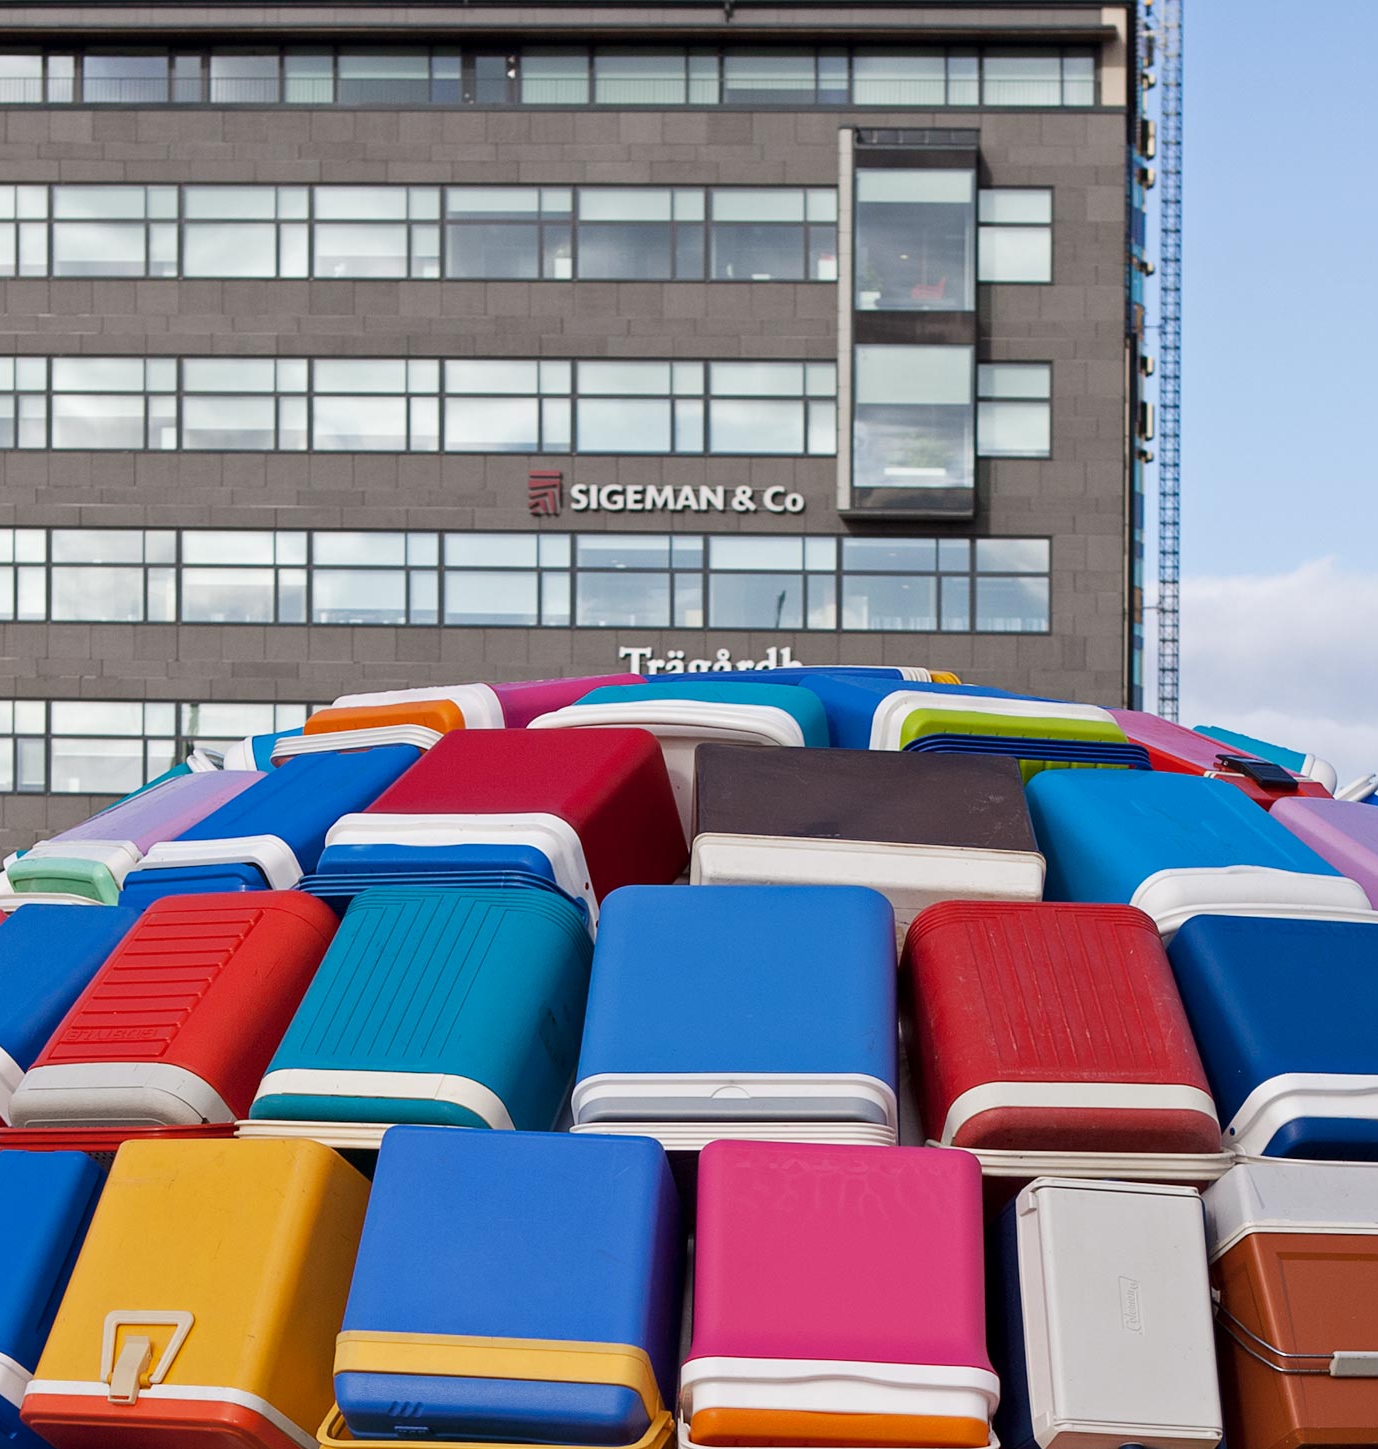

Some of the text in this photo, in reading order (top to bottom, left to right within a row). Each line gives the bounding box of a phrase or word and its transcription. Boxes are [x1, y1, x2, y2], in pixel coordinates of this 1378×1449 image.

[570, 484, 805, 512] SIGEMAN & Co
